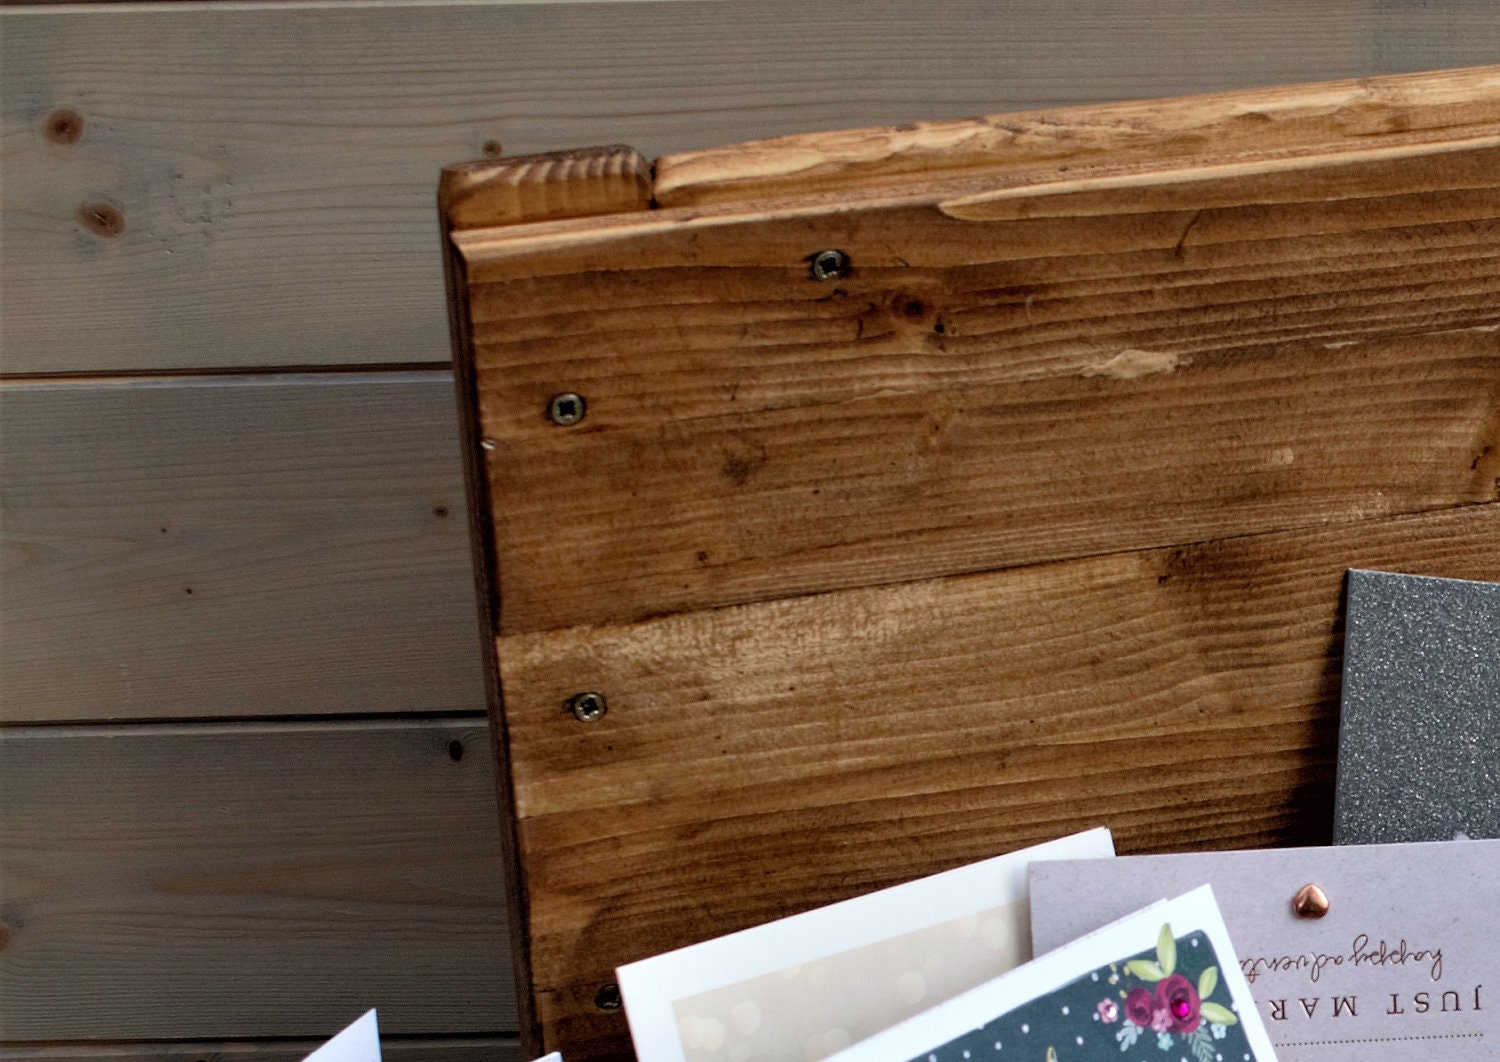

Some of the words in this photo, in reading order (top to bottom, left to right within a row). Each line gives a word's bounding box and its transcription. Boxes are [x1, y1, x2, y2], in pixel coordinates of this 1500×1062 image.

[1352, 933, 1443, 982] happy
[1255, 994, 1360, 1021] MAR
[1387, 984, 1483, 1016] JUST
